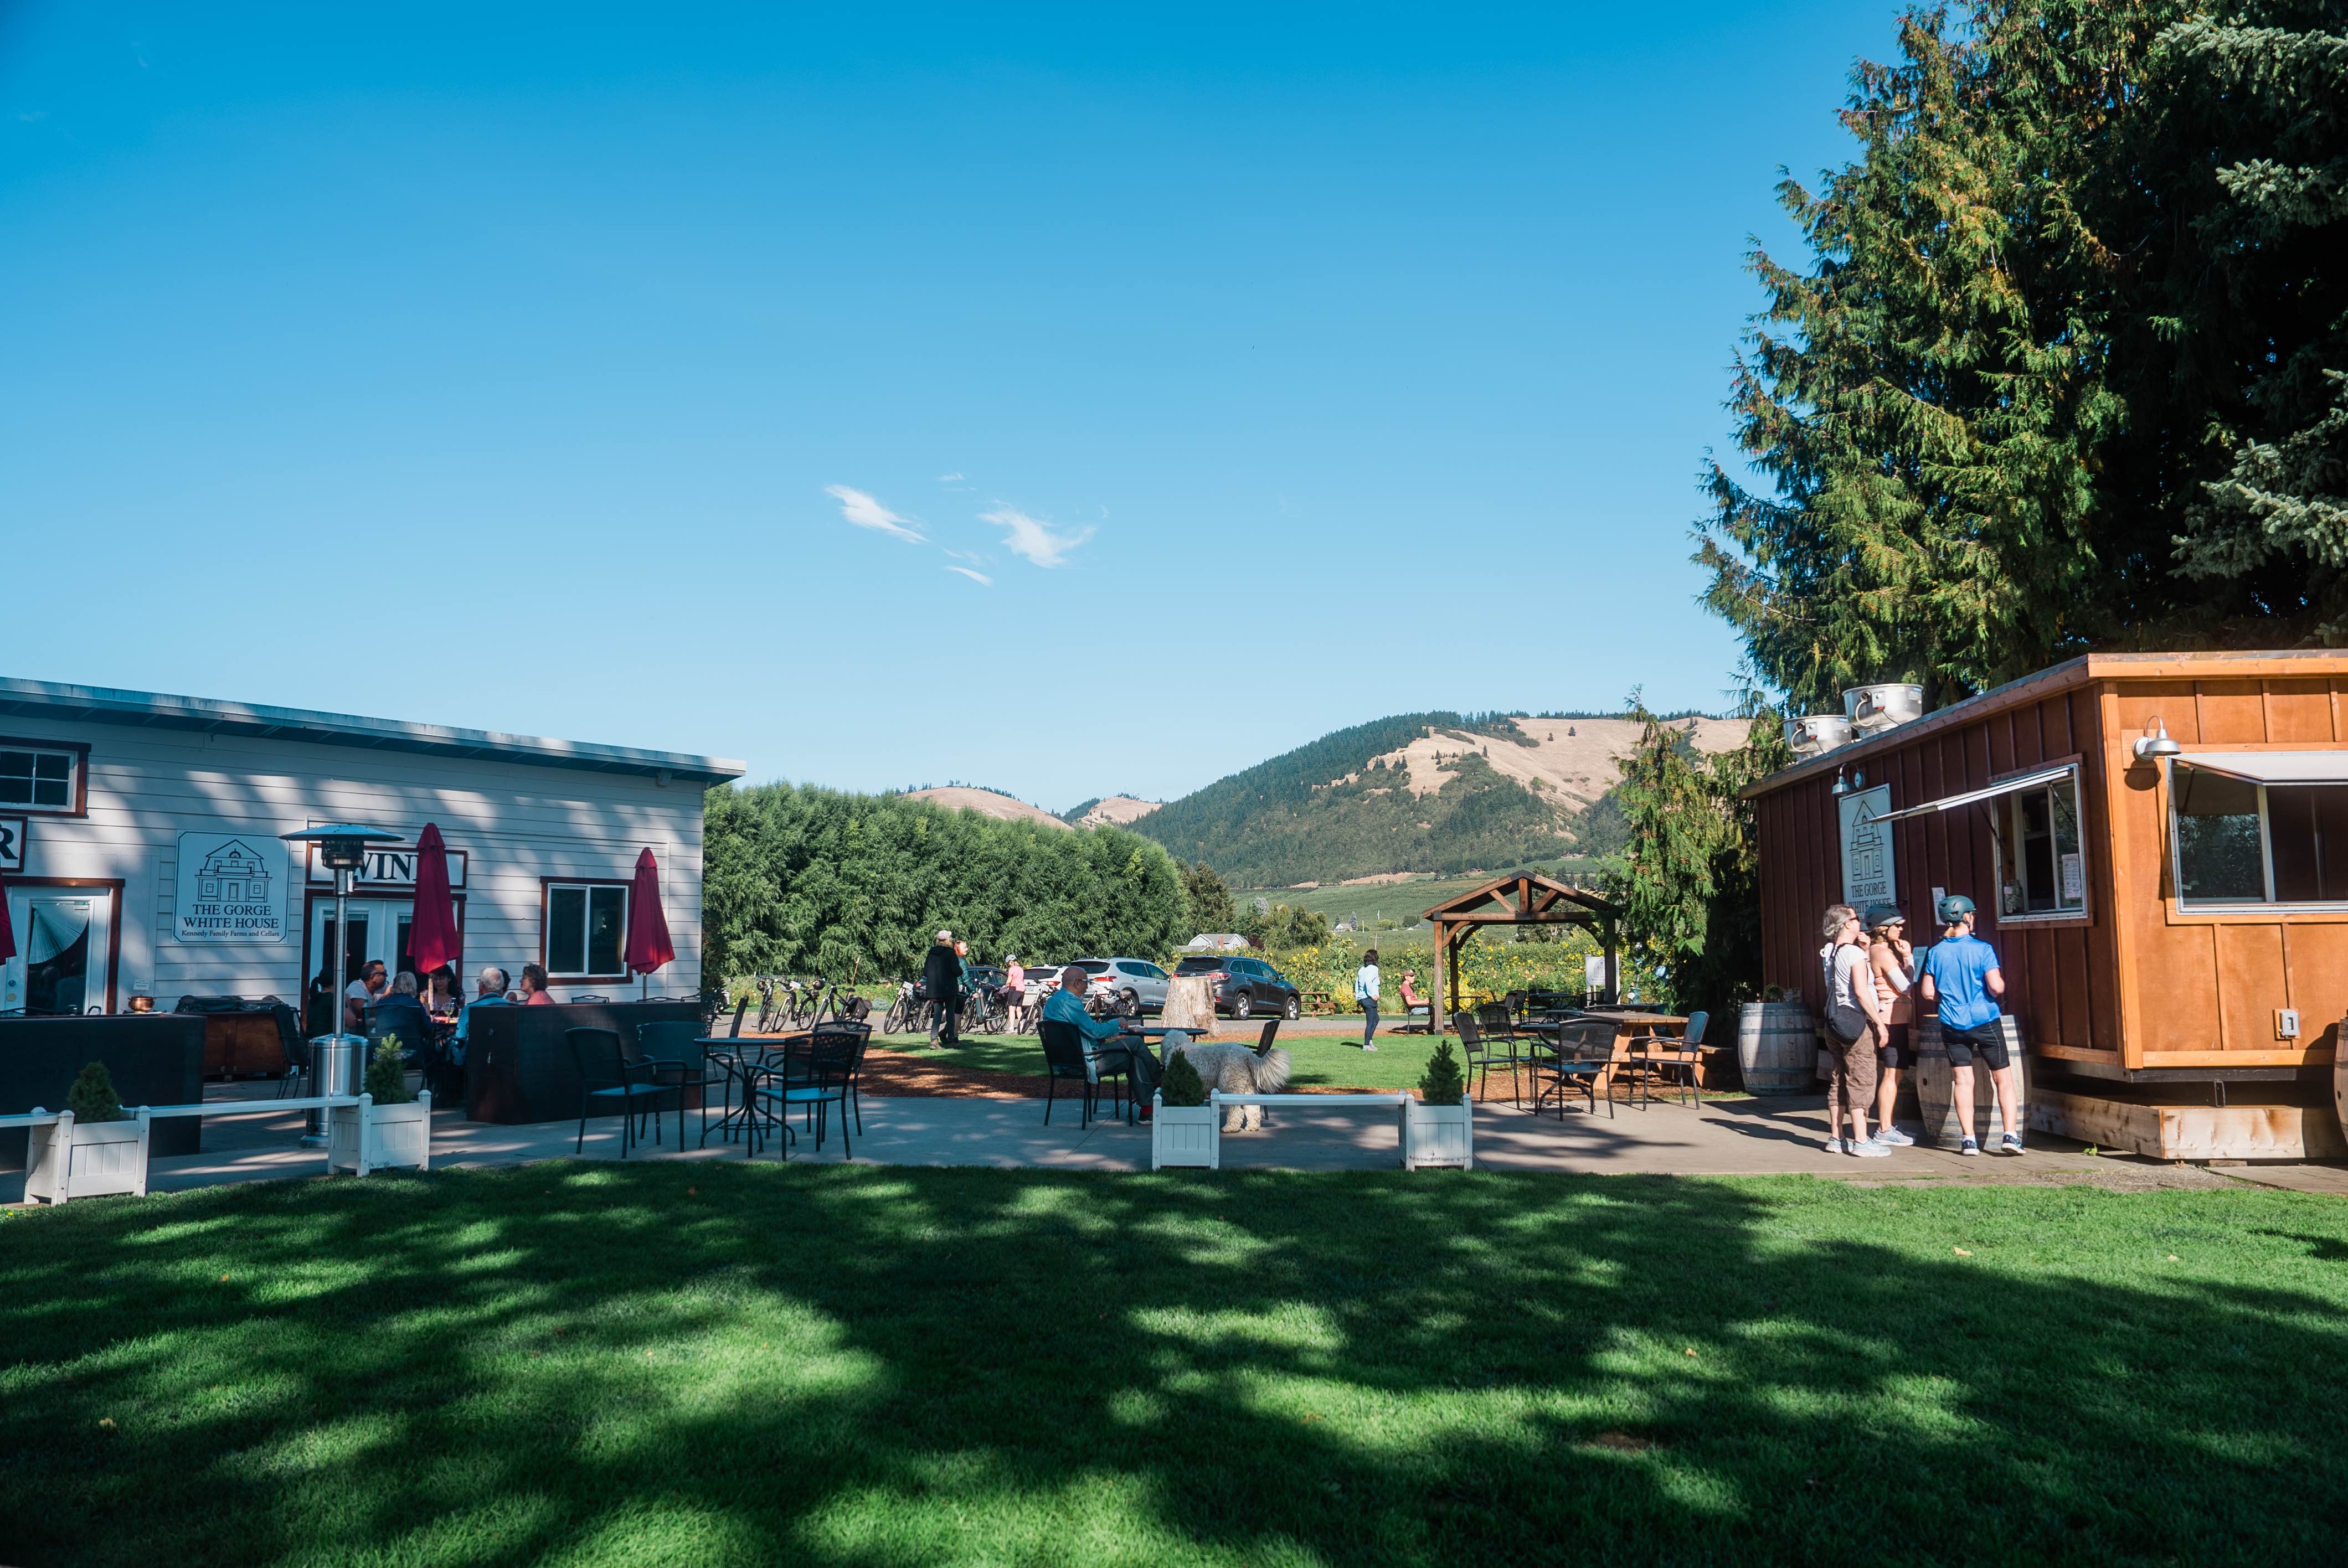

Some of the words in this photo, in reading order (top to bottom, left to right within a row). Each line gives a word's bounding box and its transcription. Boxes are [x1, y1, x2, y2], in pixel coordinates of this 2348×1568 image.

[354, 852, 418, 881] IN
[1851, 885, 1863, 898] THE
[1865, 881, 1887, 896] GORGE
[192, 904, 220, 915] THE
[224, 905, 271, 915] GORGE
[184, 917, 231, 928] WHITE
[235, 918, 279, 929] HOUSE
